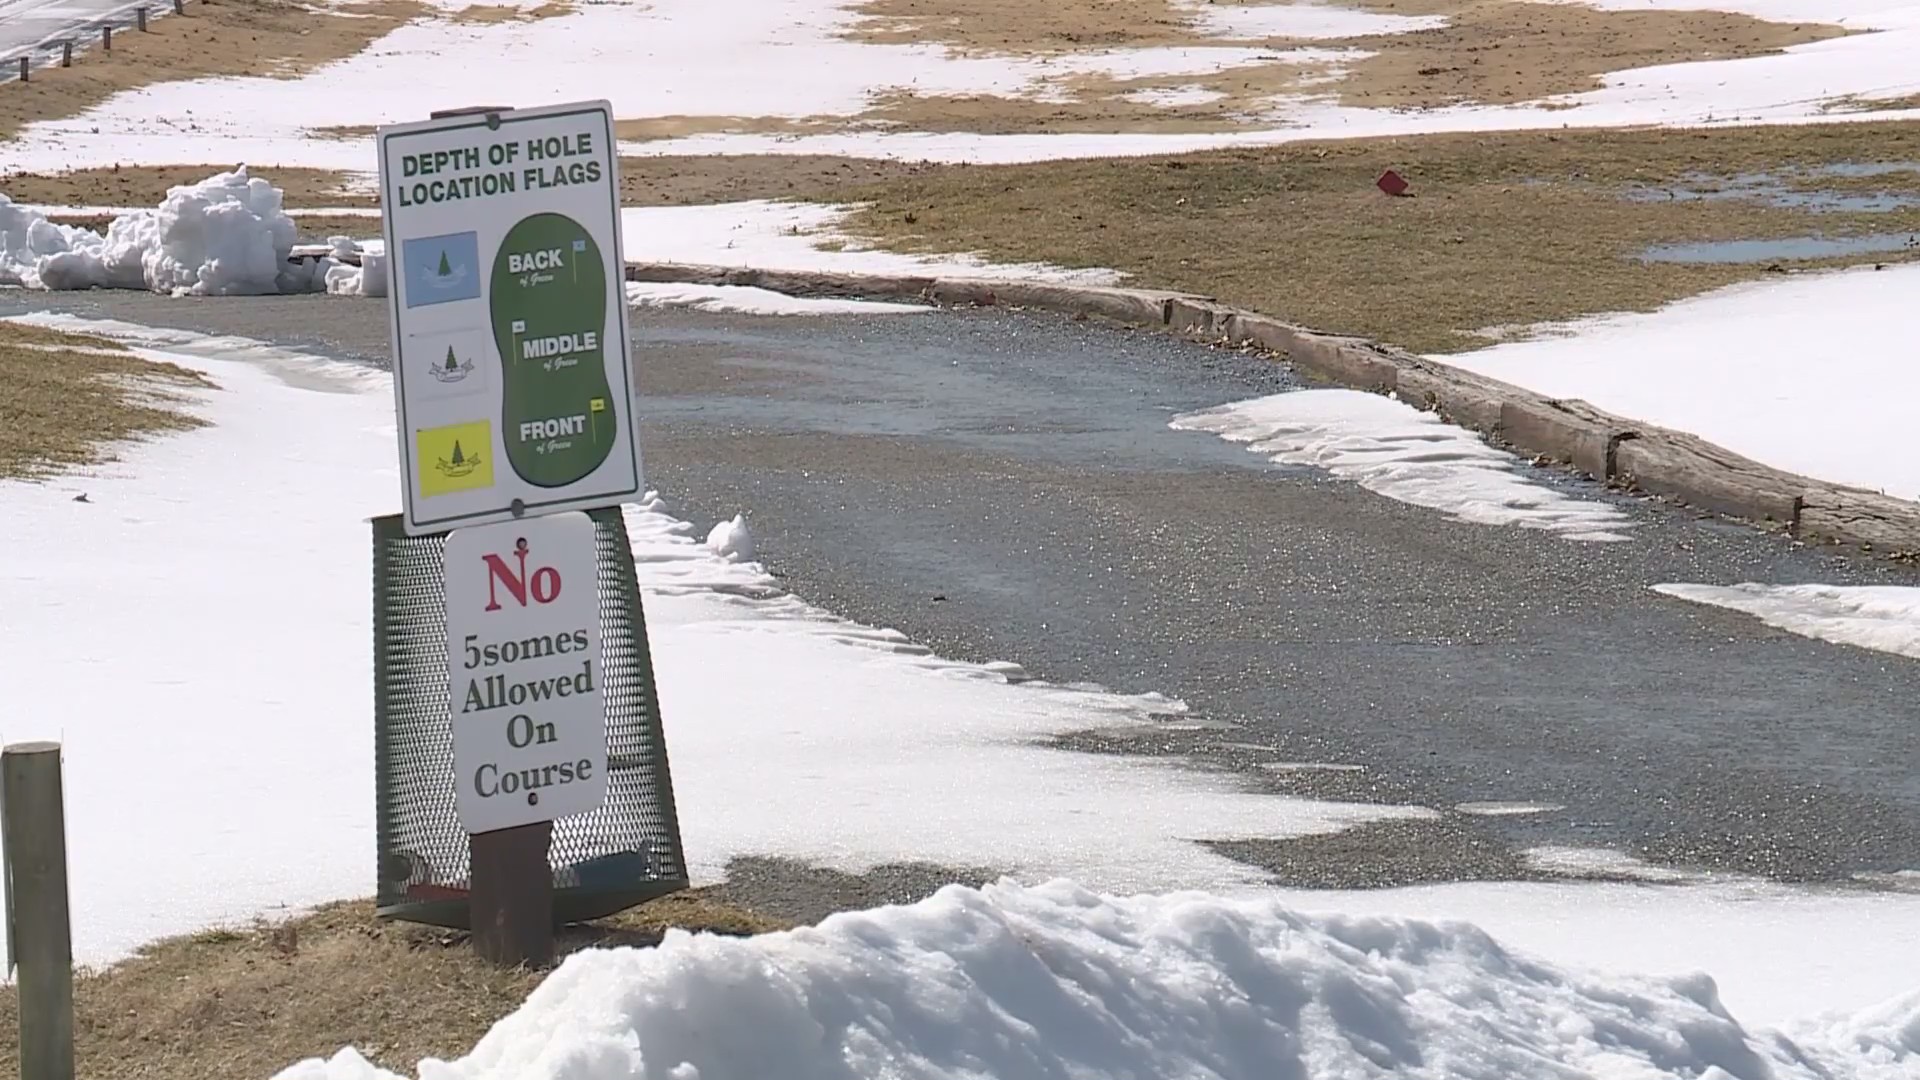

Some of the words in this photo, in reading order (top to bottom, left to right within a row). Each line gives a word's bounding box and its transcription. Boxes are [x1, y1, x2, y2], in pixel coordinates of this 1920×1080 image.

[402, 147, 480, 177] DEPTH
[488, 142, 519, 166] OF
[527, 133, 593, 161] HOLE
[398, 171, 515, 207] LOCATION
[523, 160, 601, 190] FLAGS
[508, 248, 564, 273] BACK
[519, 275, 528, 287] of
[530, 272, 554, 287] Green
[522, 332, 598, 359] MIDDLE
[543, 360, 552, 372] of
[554, 356, 578, 371] Green
[520, 415, 586, 442] FRONT
[536, 443, 545, 455] of
[547, 440, 571, 454] Green
[481, 549, 562, 612] No
[464, 628, 589, 670] 5somes
[461, 660, 595, 714] Allowed
[506, 714, 558, 748] On
[474, 758, 592, 798] Course
